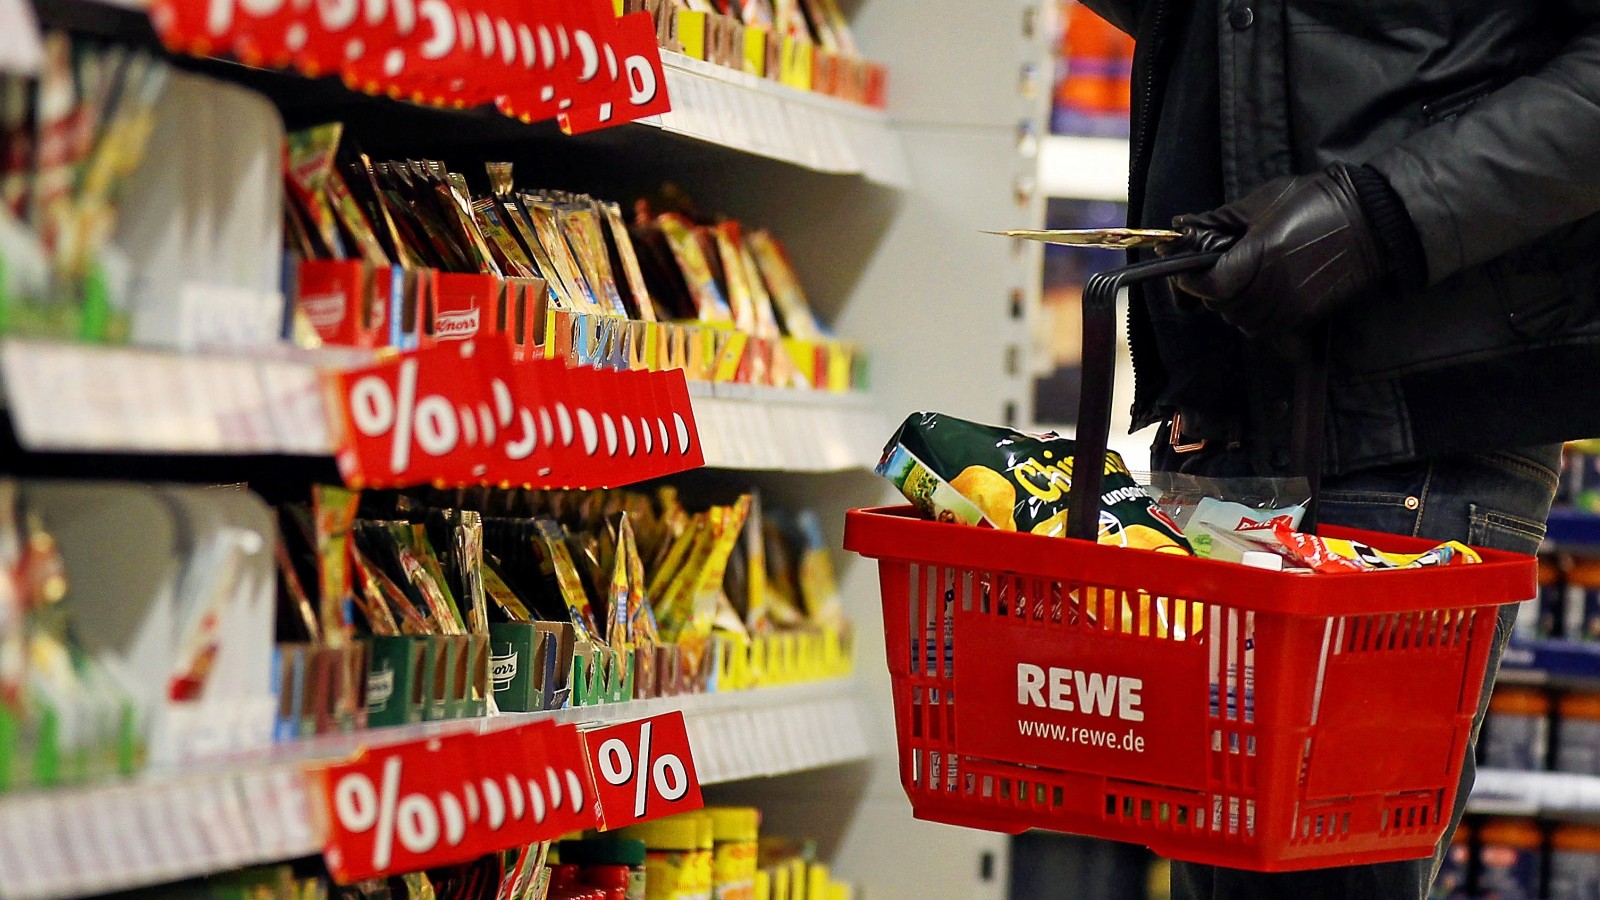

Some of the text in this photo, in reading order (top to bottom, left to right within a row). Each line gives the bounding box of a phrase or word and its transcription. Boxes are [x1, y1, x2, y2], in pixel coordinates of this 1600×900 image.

[351, 358, 459, 474] %
[1017, 662, 1144, 722] REWE
[1018, 719, 1145, 753] www.rewe.de
[335, 757, 440, 870] %
[598, 722, 687, 817] %
